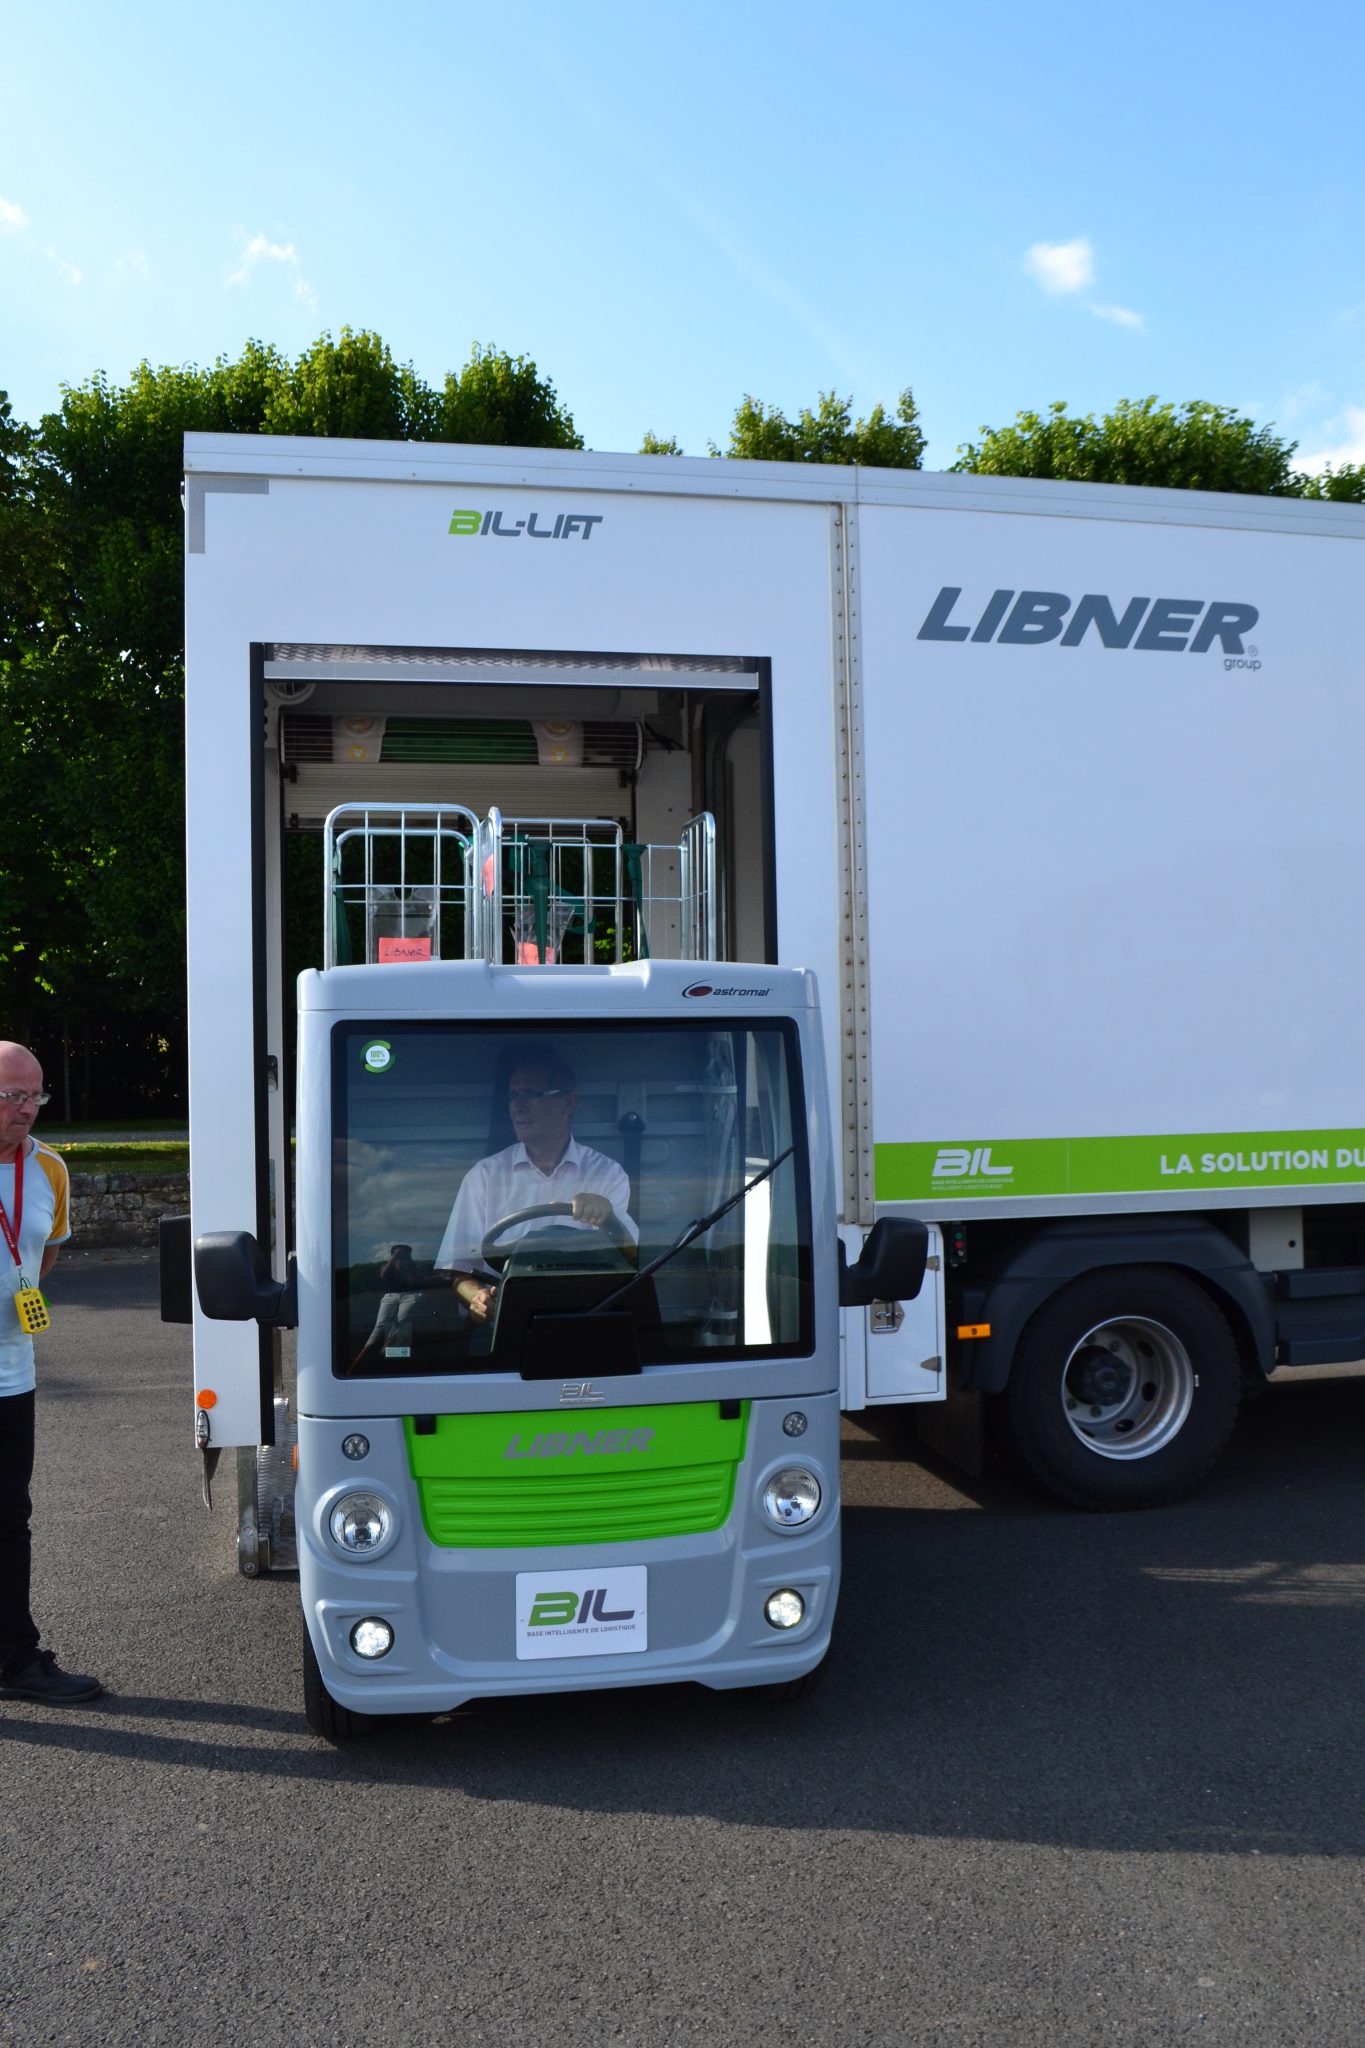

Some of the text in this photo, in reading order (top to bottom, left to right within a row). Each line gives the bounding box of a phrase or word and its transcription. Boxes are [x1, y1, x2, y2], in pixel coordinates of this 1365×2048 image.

[448, 509, 603, 540] BIL-LIFT
[916, 586, 1259, 655] LIBNER
[1223, 658, 1262, 672] group
[713, 987, 770, 996] astromal
[931, 1147, 1014, 1177] BIL
[1160, 1148, 1365, 1175] LA SOLUTION DU
[503, 1427, 656, 1460] LIBNER
[528, 1588, 636, 1627] BIL
[600, 1624, 636, 1632] LOGISTIQUE
